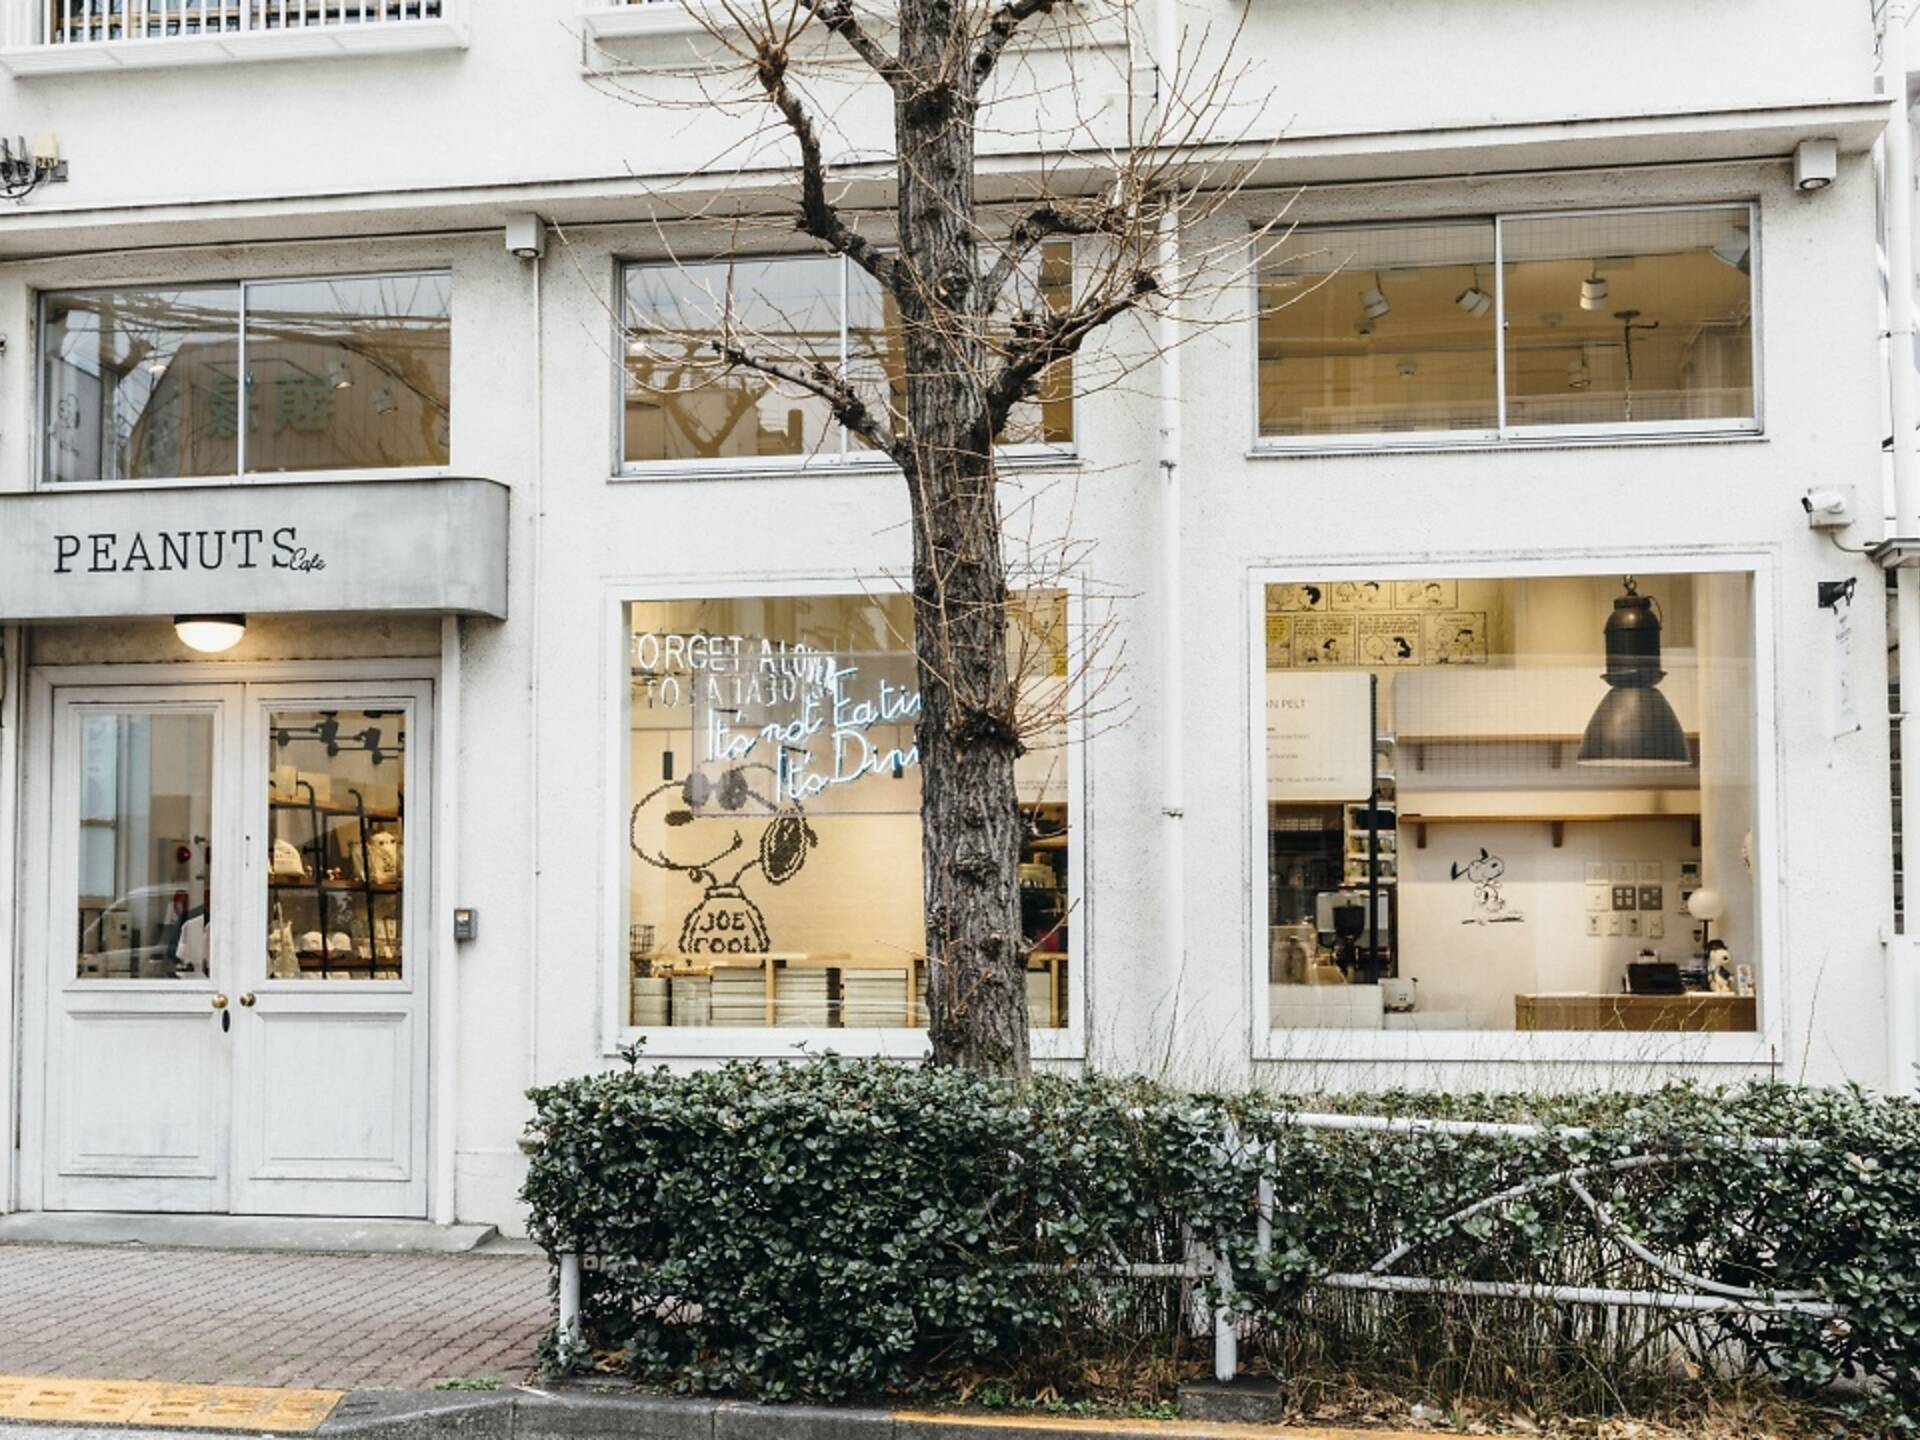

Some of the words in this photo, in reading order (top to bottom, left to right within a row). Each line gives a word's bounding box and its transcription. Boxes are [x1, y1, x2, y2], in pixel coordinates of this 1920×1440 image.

[53, 526, 298, 574] PEANUTS
[288, 547, 327, 573] Cafe
[762, 697, 823, 744] not
[699, 909, 745, 932] JOE
